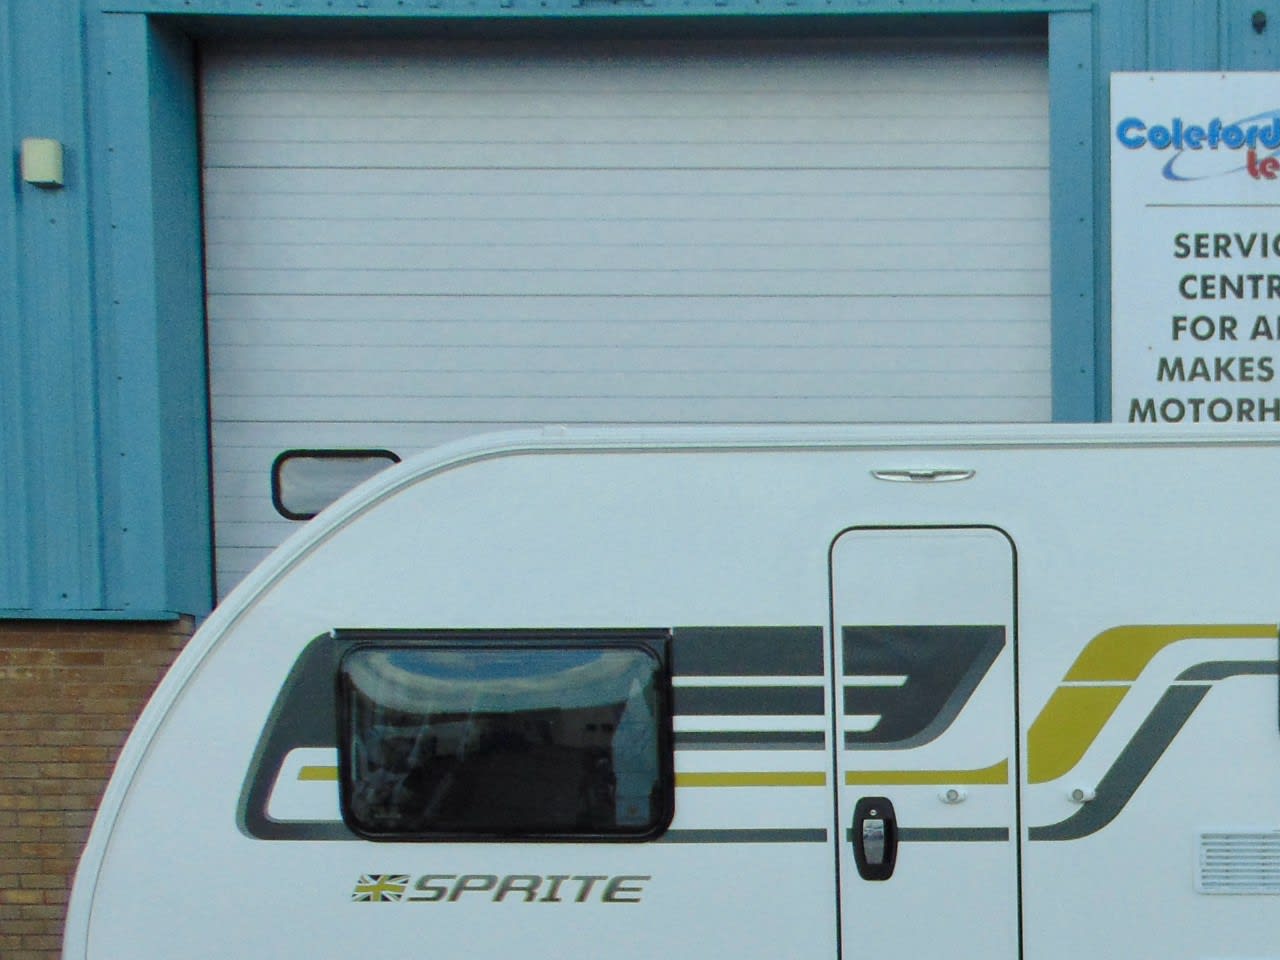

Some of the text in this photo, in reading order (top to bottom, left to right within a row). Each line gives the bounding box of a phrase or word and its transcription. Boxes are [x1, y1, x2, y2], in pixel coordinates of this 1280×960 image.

[1171, 315, 1238, 342] FOR
[1156, 356, 1275, 383] MAKES
[405, 874, 652, 903] SPRITE
